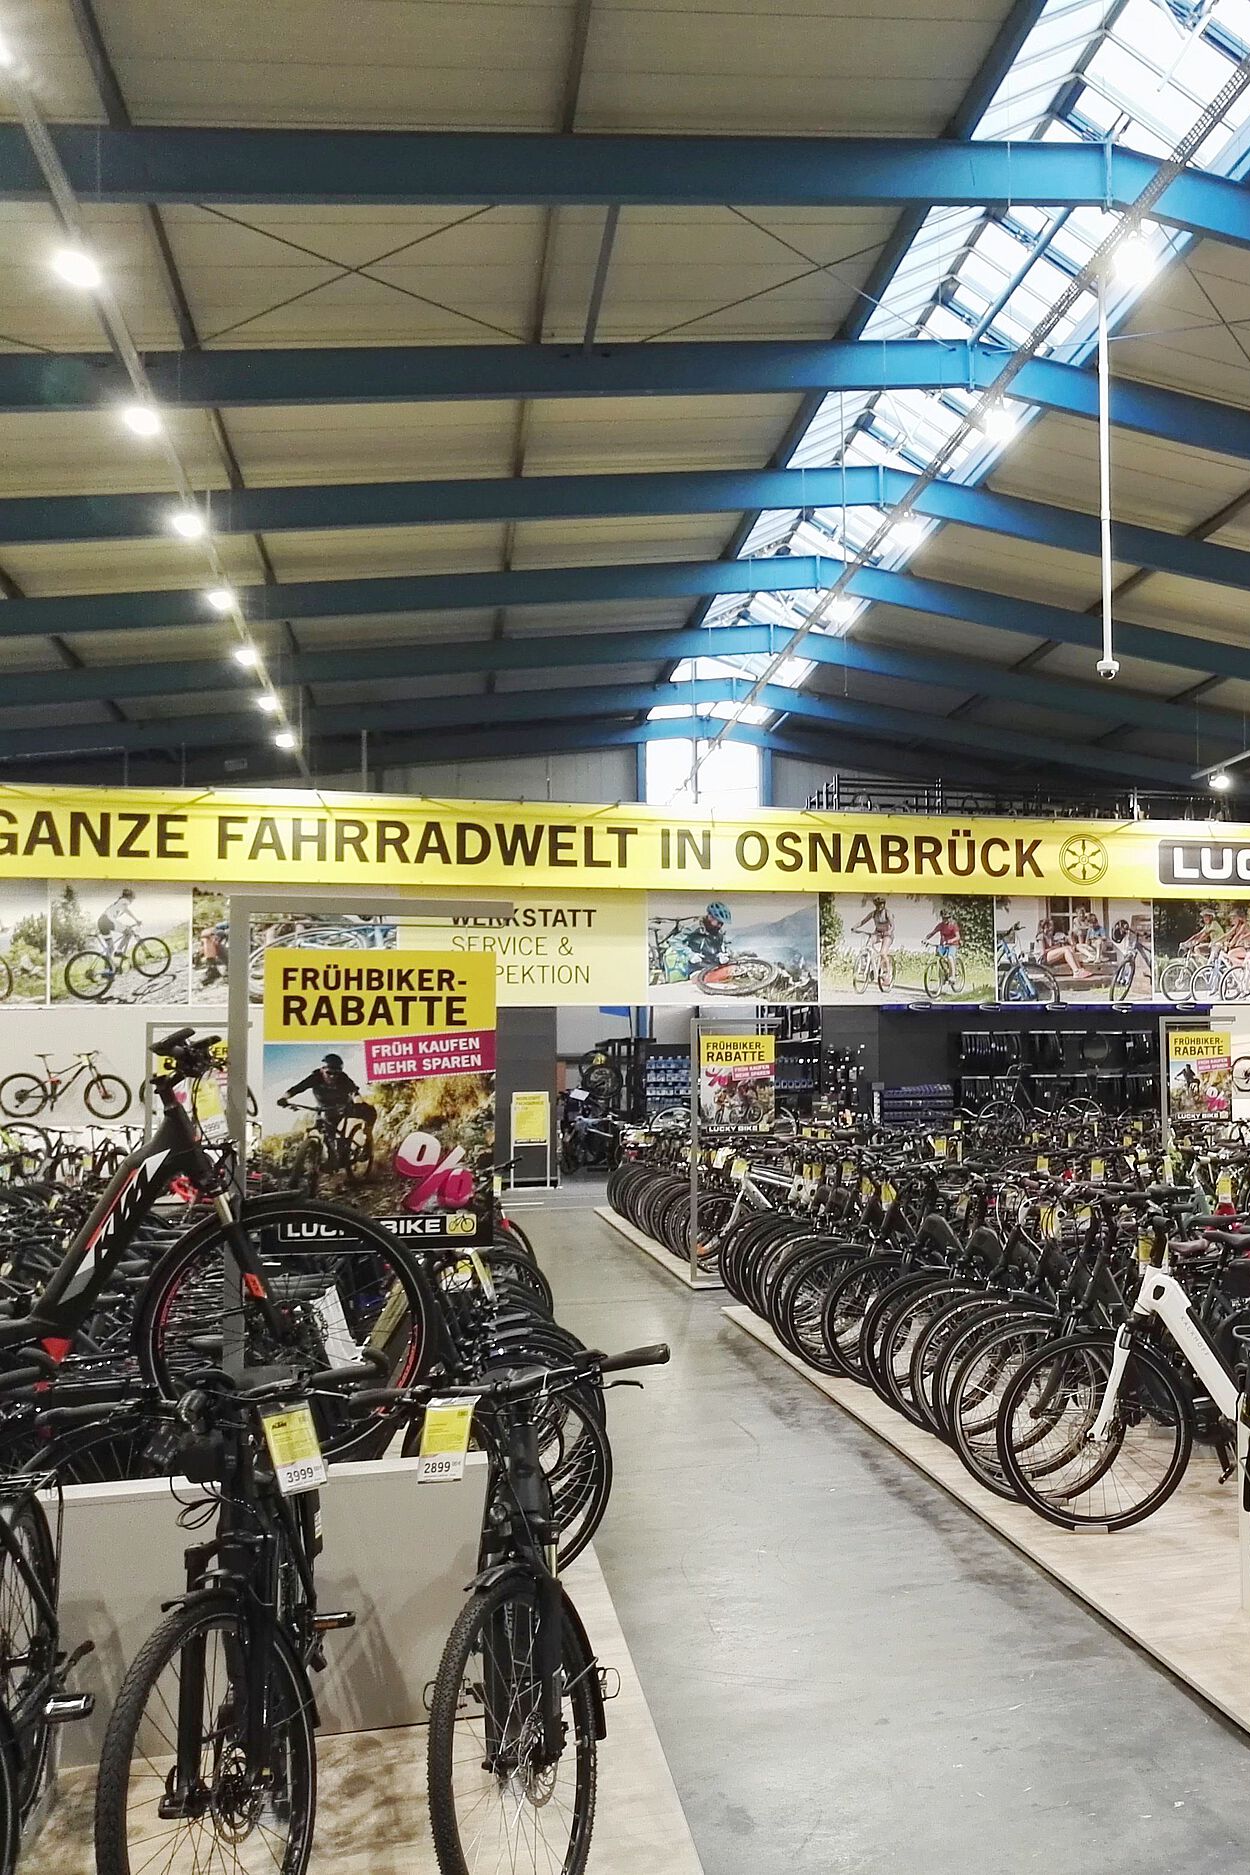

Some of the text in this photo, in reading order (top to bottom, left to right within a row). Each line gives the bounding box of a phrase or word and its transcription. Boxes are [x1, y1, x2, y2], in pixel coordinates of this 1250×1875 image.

[217, 815, 638, 868] FAHRRADWELT
[660, 828, 711, 870] IN
[735, 829, 1044, 878] OSNABRÜCK
[452, 935, 574, 956] SERVICE &
[282, 964, 467, 991] FRÜHBIKER-
[283, 995, 467, 1026] RABATTE
[372, 1037, 480, 1058] FRÜH KAUFEN
[706, 1040, 765, 1050] FRÜHBIKER-
[1174, 1036, 1224, 1046] FRÜHBIKER-
[706, 1051, 766, 1062] RABATTE
[1174, 1046, 1224, 1056] RABATTE
[372, 1054, 482, 1075] MEHR SPAREN
[286, 1466, 314, 1483] 3999
[423, 1461, 451, 1474] 2899
